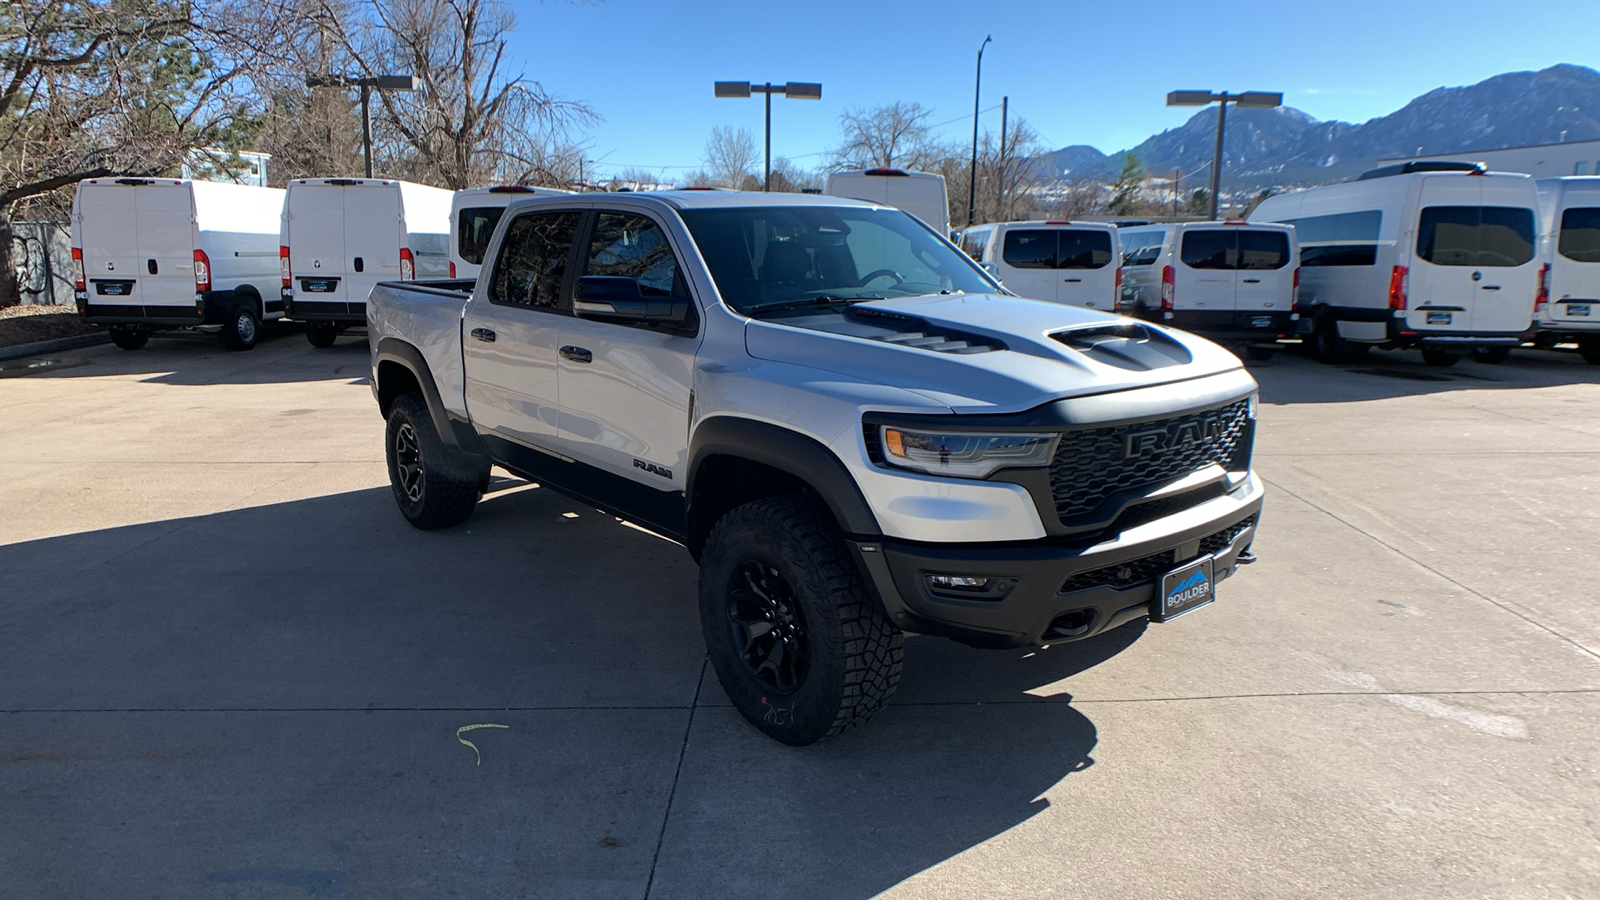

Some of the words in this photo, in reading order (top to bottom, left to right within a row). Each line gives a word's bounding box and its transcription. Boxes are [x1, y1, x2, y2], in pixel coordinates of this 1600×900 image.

[1126, 412, 1232, 458] RAM
[633, 458, 673, 480] RAM
[1167, 582, 1210, 607] BOULDER
